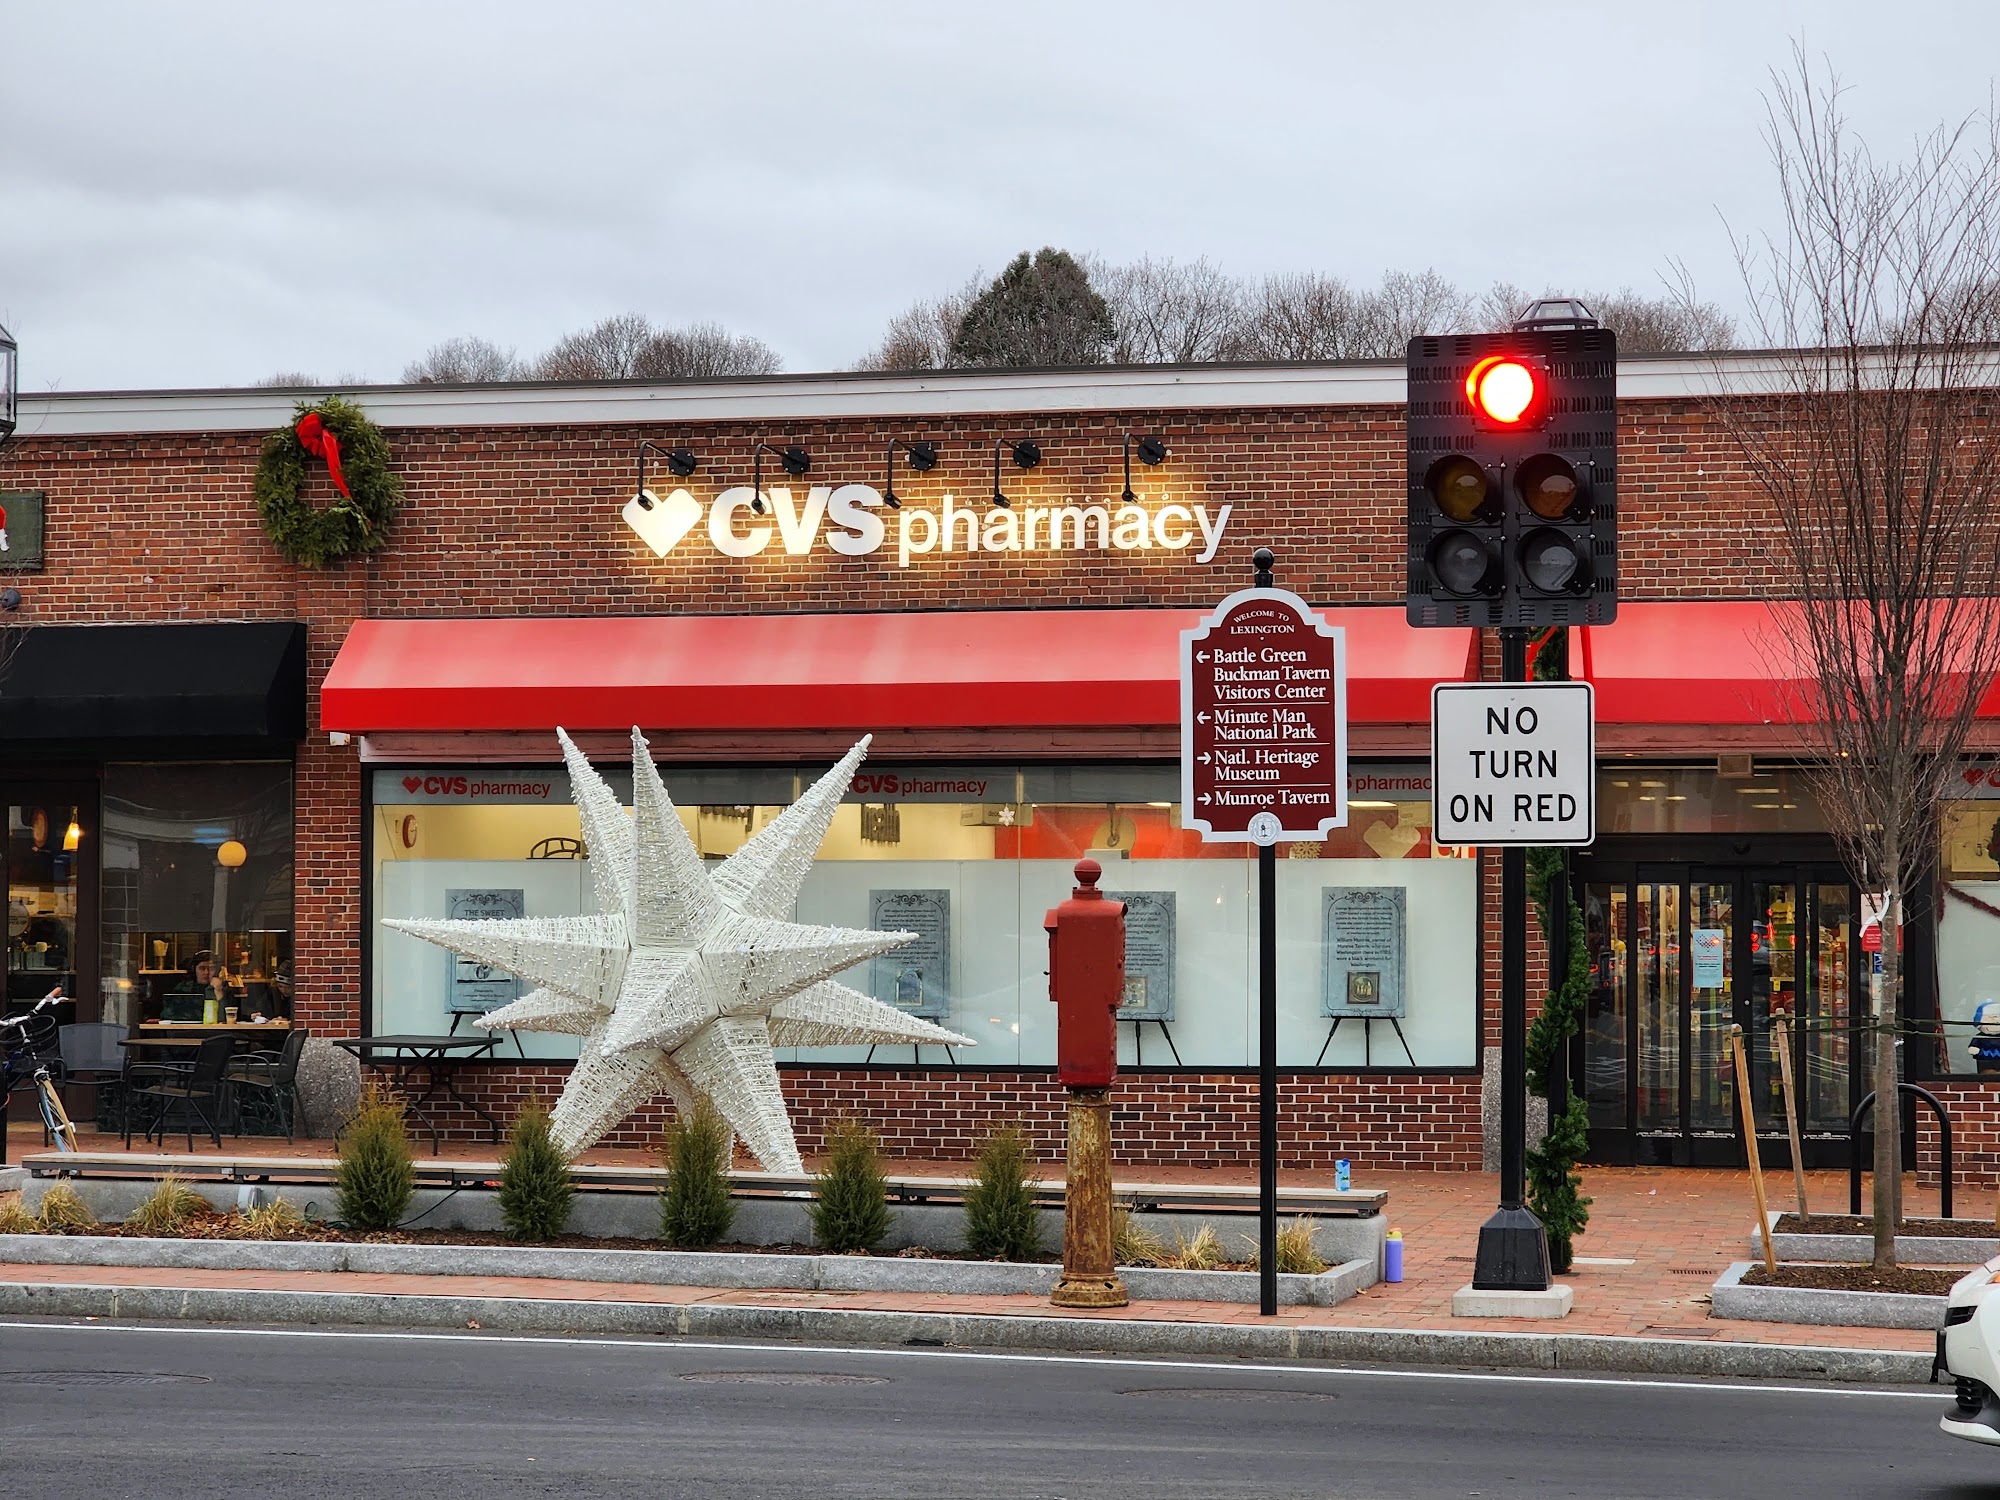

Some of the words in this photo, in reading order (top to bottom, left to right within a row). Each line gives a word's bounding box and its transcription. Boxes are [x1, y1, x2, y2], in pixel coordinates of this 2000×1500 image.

[708, 485, 885, 558] CVS
[899, 495, 1233, 567] pharmacy
[1233, 610, 1274, 622] WELCOME
[1278, 612, 1289, 621] TO
[1230, 625, 1295, 634] LEXINGTON
[1213, 647, 1256, 663] Battle
[1261, 647, 1307, 663] Green
[1213, 666, 1280, 681] Buckman
[1281, 665, 1331, 680] Tavern
[1213, 684, 1270, 700] Visitors
[1275, 684, 1326, 699] Center
[1214, 708, 1268, 724] Minute
[1273, 708, 1306, 723] Man
[1487, 706, 1539, 735] NO
[1214, 724, 1278, 740] National
[1282, 724, 1317, 739] Park
[1214, 749, 1250, 766] Natl.
[1255, 749, 1319, 769] Heritage
[1469, 750, 1557, 779] TURN
[1214, 766, 1280, 781] Museum
[423, 776, 467, 795] CVS
[470, 780, 550, 798] pharmacy
[852, 775, 898, 793] CVS
[902, 778, 987, 796] pharmacy
[1356, 775, 1432, 793] pharmac
[1214, 790, 1274, 806] Munroe
[1278, 790, 1330, 805] Tavern
[1449, 794, 1493, 823] ON
[1514, 794, 1577, 822] RED
[480, 909, 504, 917] SWEET
